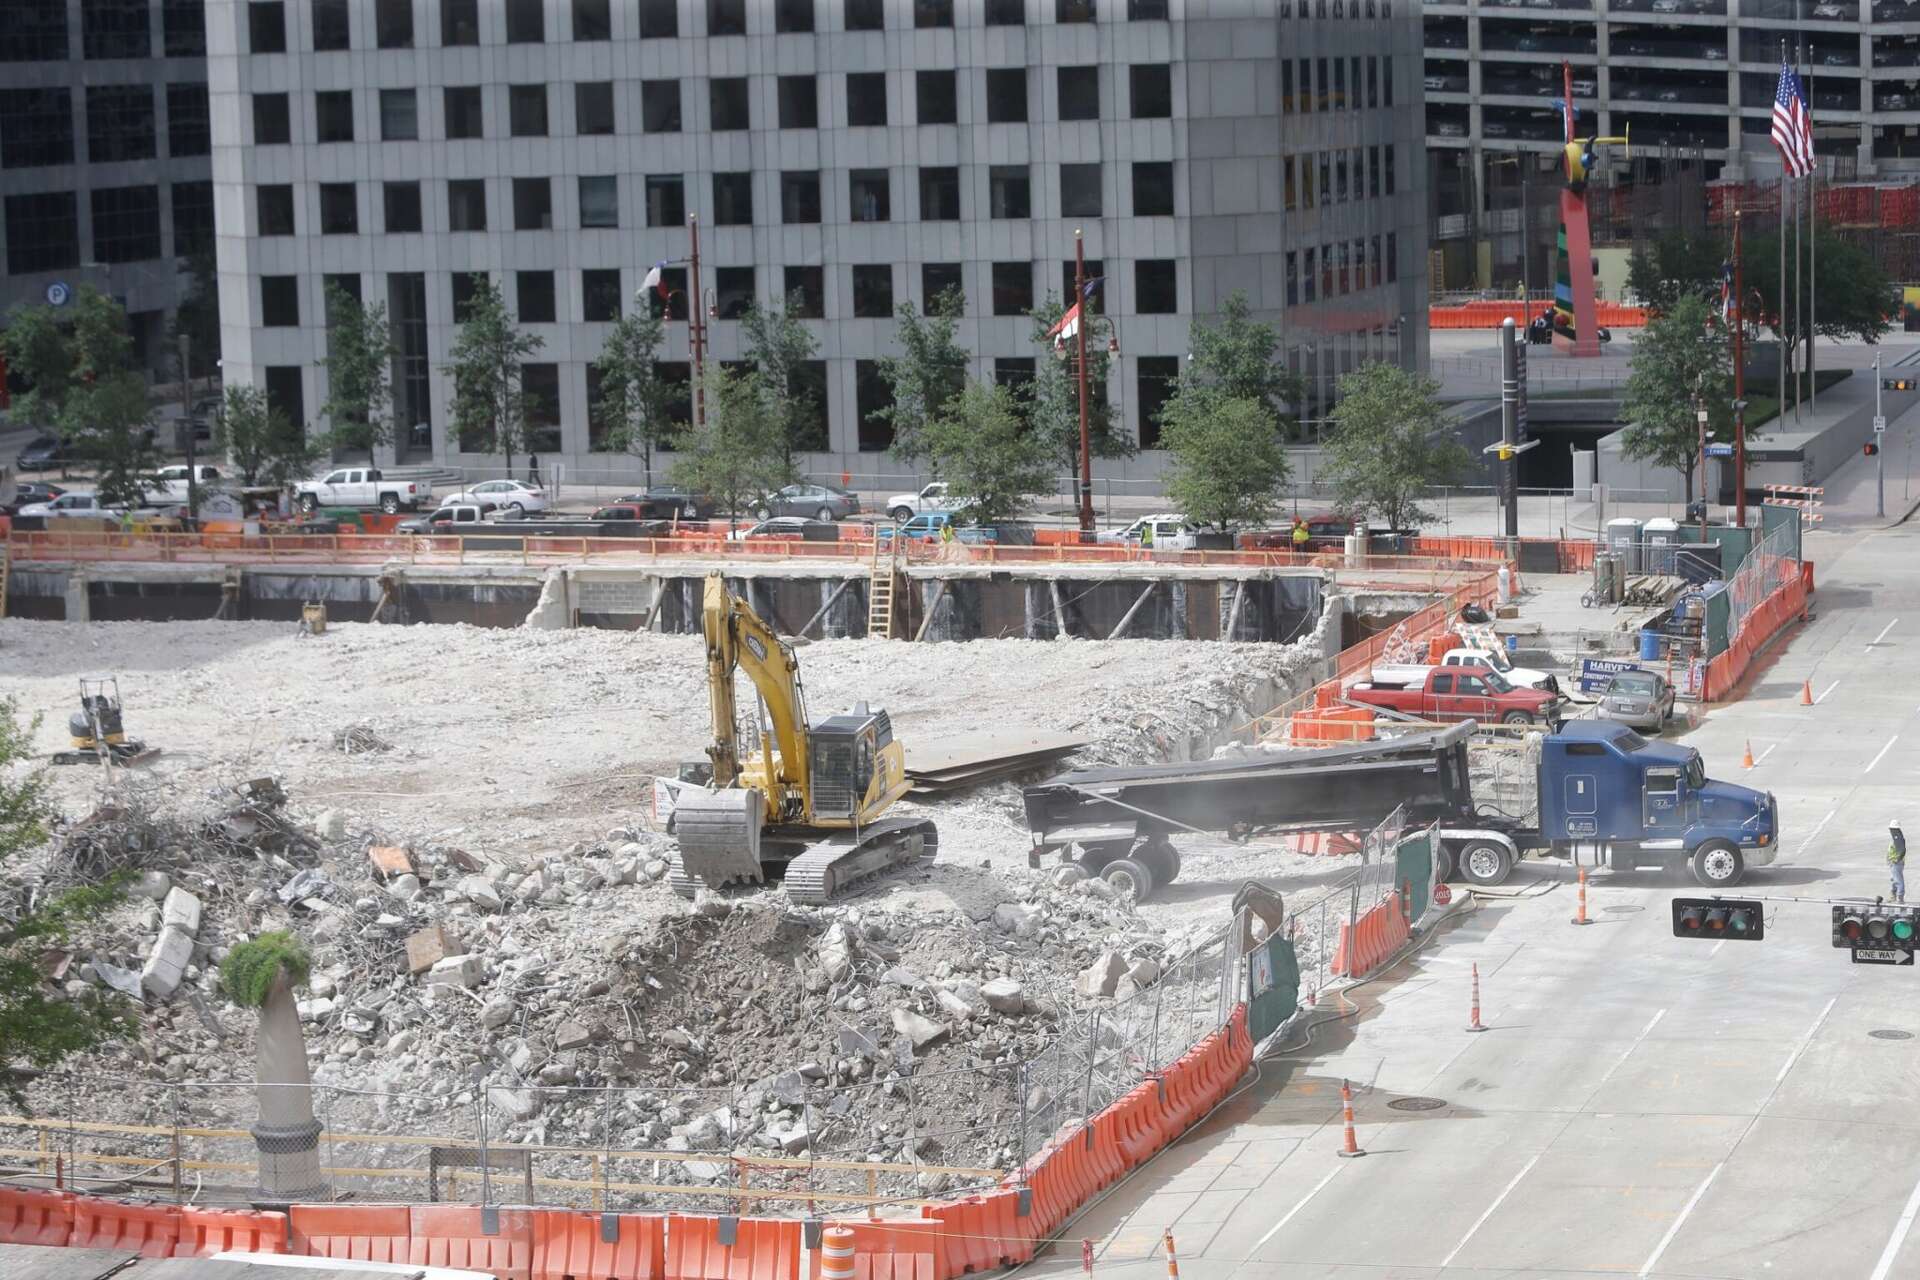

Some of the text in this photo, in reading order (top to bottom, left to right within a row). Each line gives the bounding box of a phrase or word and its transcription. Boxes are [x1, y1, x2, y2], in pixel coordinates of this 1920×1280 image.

[1590, 661, 1632, 671] HARVEY
[1858, 950, 1896, 959] ONE WAY
